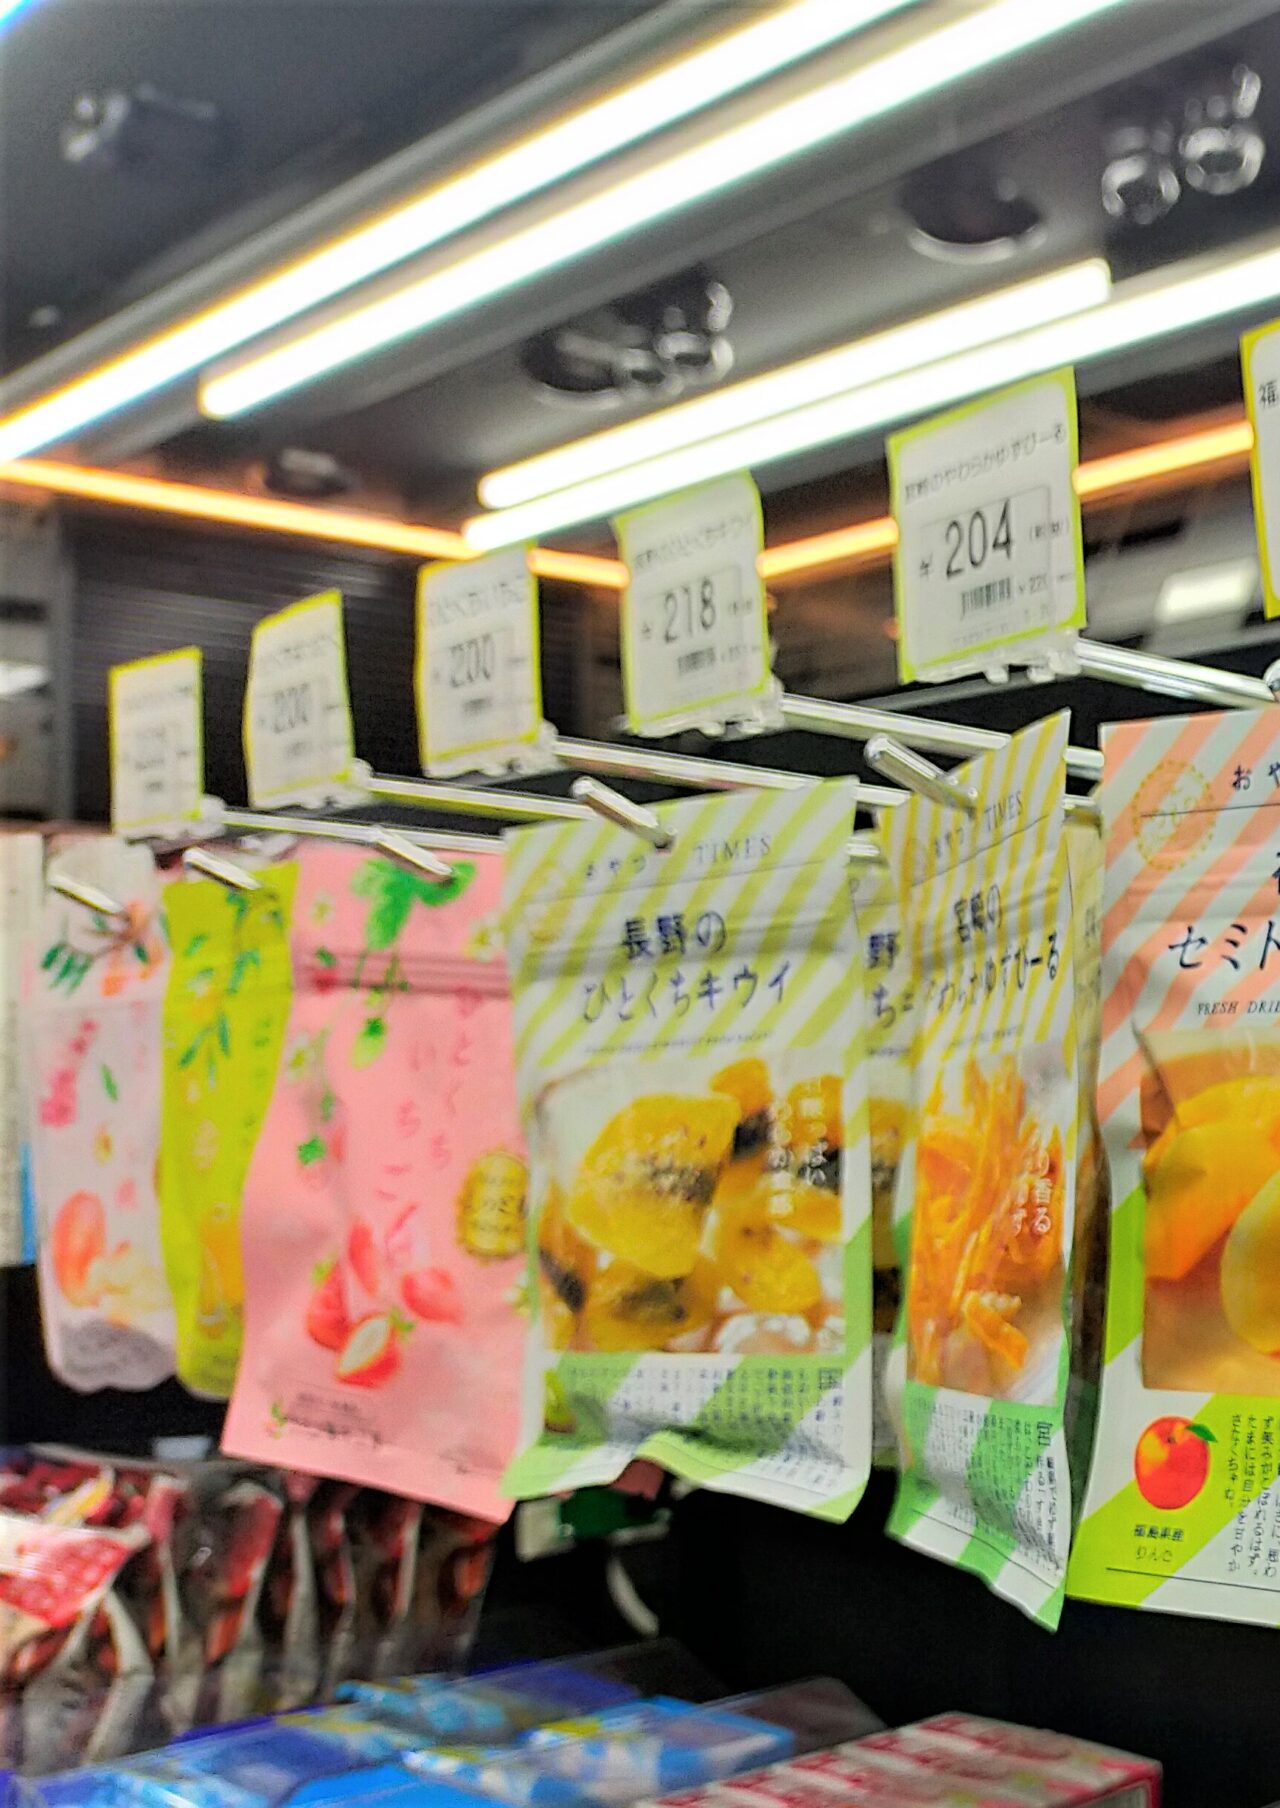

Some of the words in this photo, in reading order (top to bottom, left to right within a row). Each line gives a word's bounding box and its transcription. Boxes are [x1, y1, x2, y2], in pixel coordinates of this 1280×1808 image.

[945, 499, 1013, 579] 204
[664, 576, 717, 644] 218
[622, 910, 727, 961] 長野の
[584, 960, 791, 1022] ひとくちキウイ
